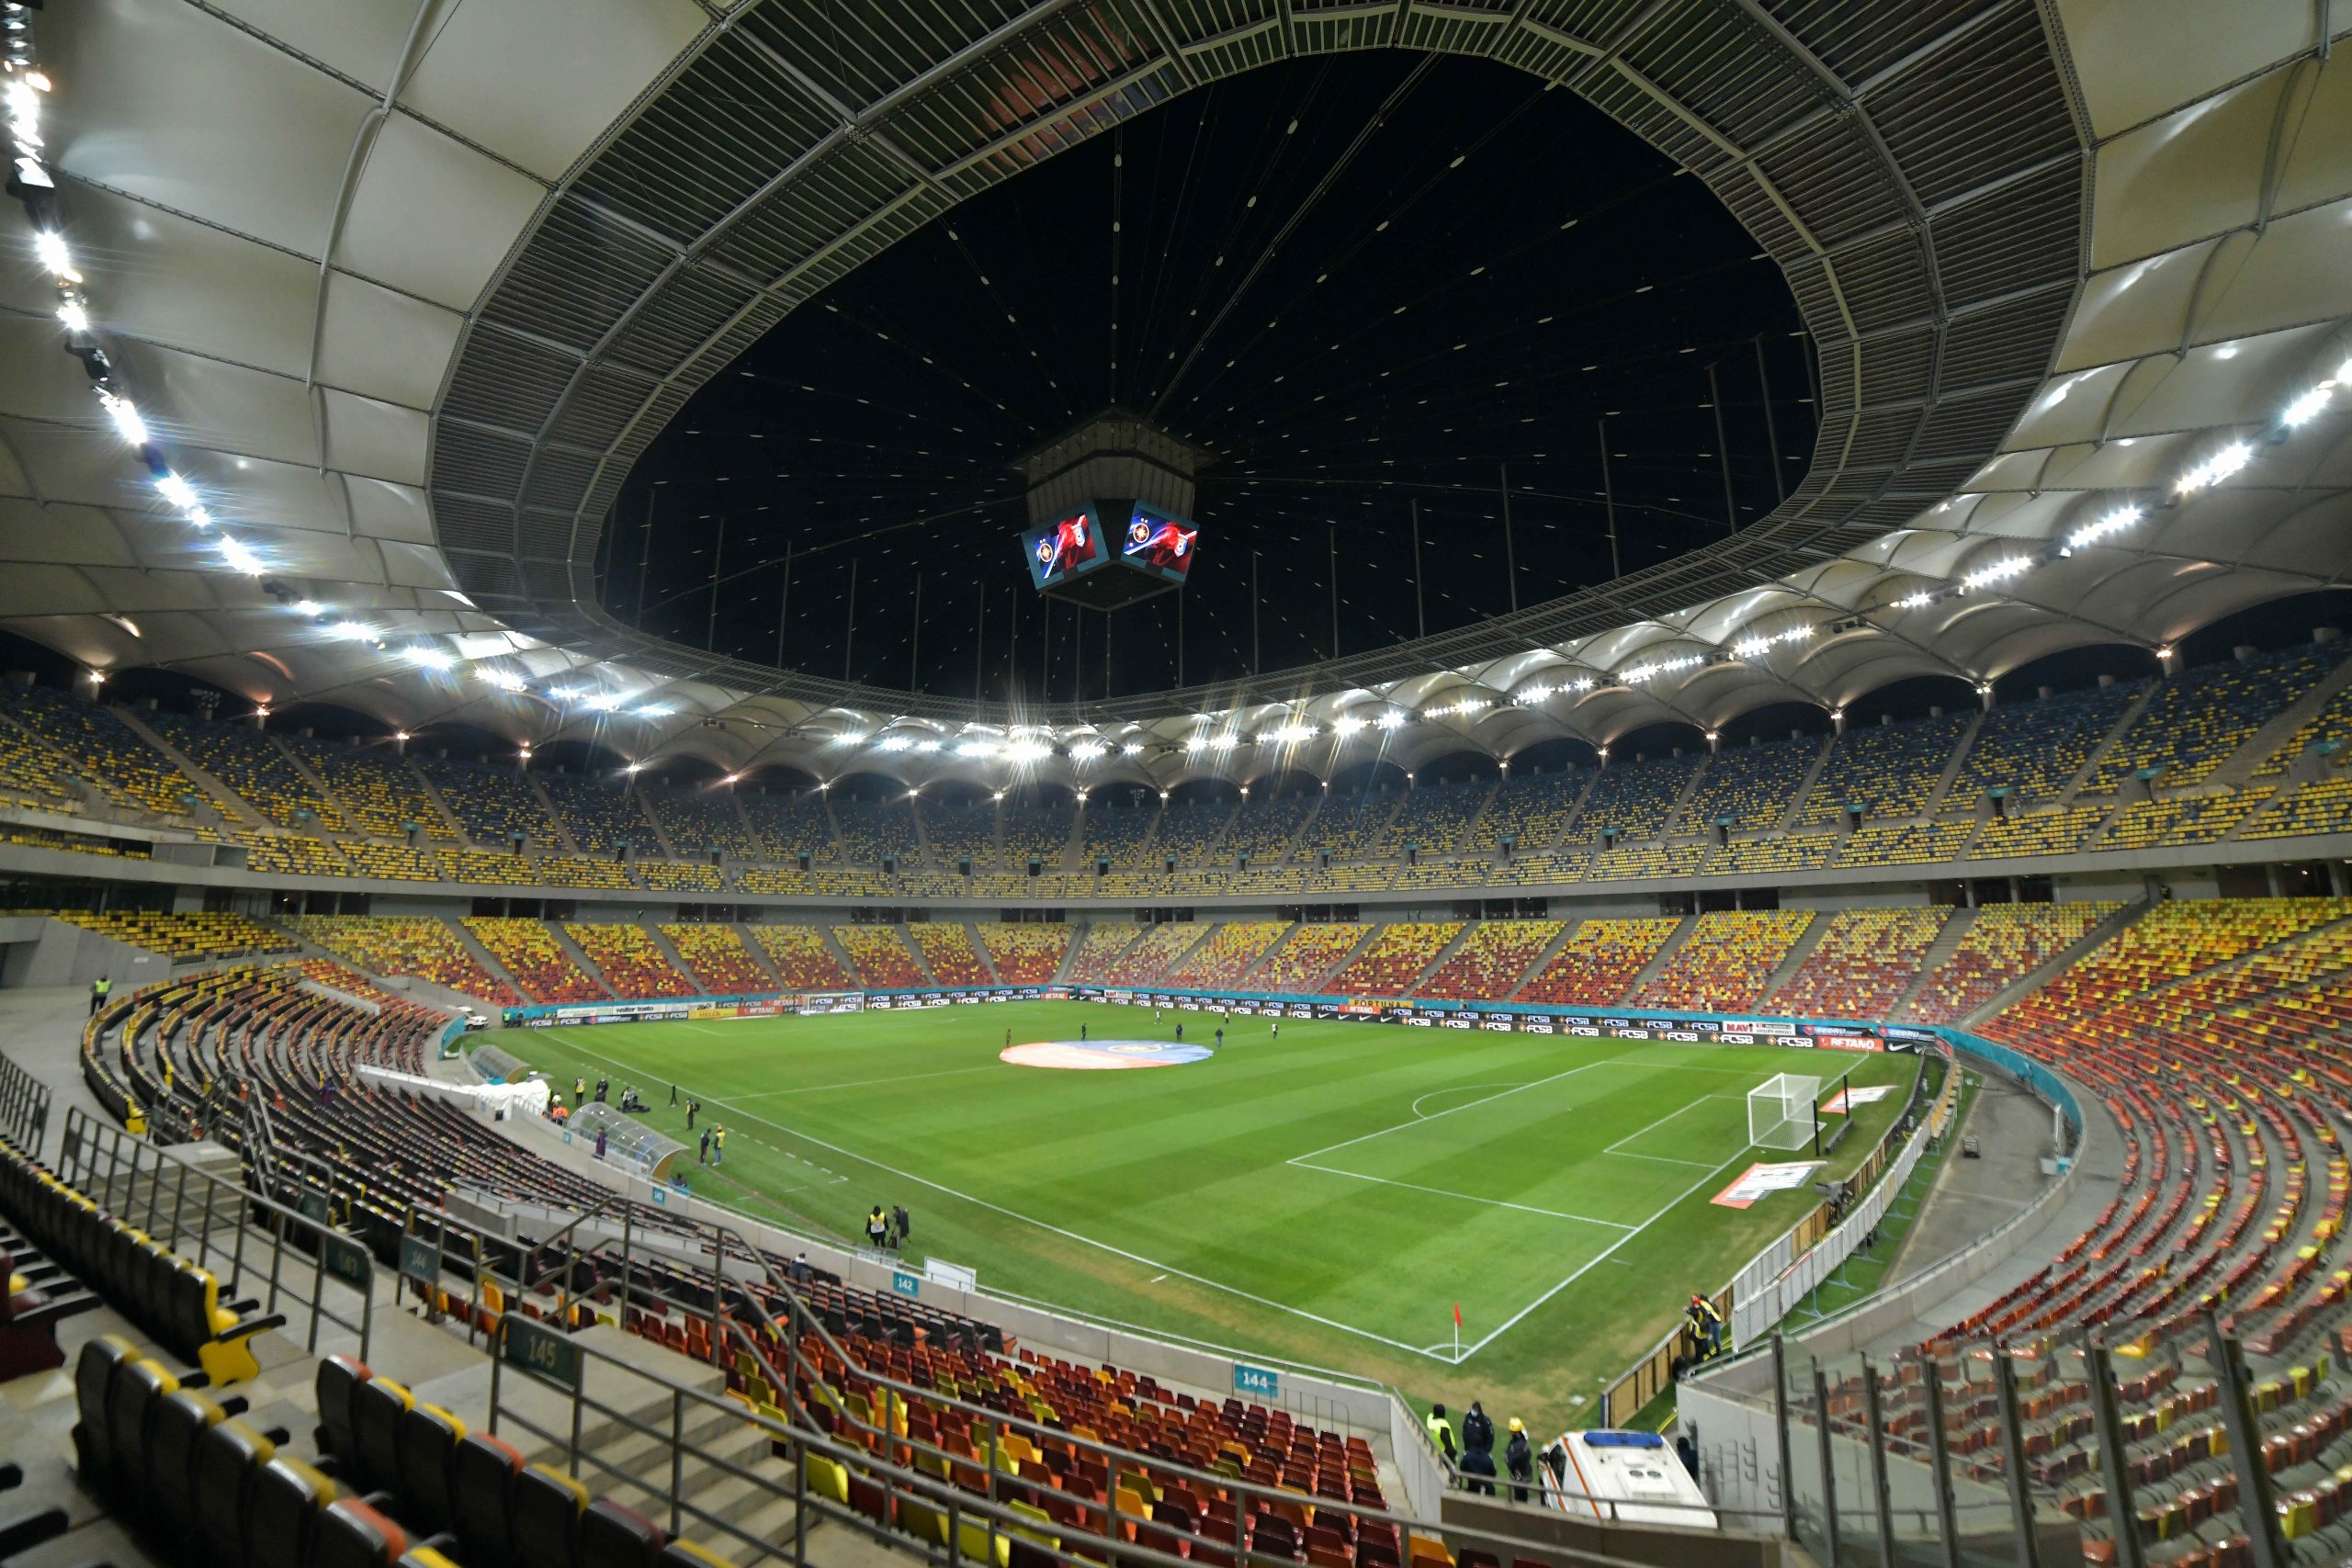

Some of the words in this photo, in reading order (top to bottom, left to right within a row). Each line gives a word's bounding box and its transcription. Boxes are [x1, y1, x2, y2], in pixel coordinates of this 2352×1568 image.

[1354, 1000, 1401, 1009] FORTUNA
[1446, 1020, 1470, 1029] FCSB
[1566, 1017, 1589, 1025] FCSB
[1604, 1019, 1629, 1027] FCSB
[1646, 1021, 1672, 1029] FCSB
[1486, 1022, 1510, 1031] FCSB
[1526, 1025, 1553, 1034] FCSB
[1691, 1022, 1719, 1031] FCSB
[1571, 1027, 1599, 1036] FCSB
[1619, 1030, 1648, 1039] FCSB
[1667, 1032, 1698, 1042] FCSB
[1720, 1034, 1754, 1044] FCSB
[1777, 1036, 1813, 1047] FCSB
[1830, 1038, 1874, 1049] BETANO
[899, 1278, 912, 1292] 142
[529, 1336, 557, 1369] 145
[1244, 1372, 1268, 1389] 144
